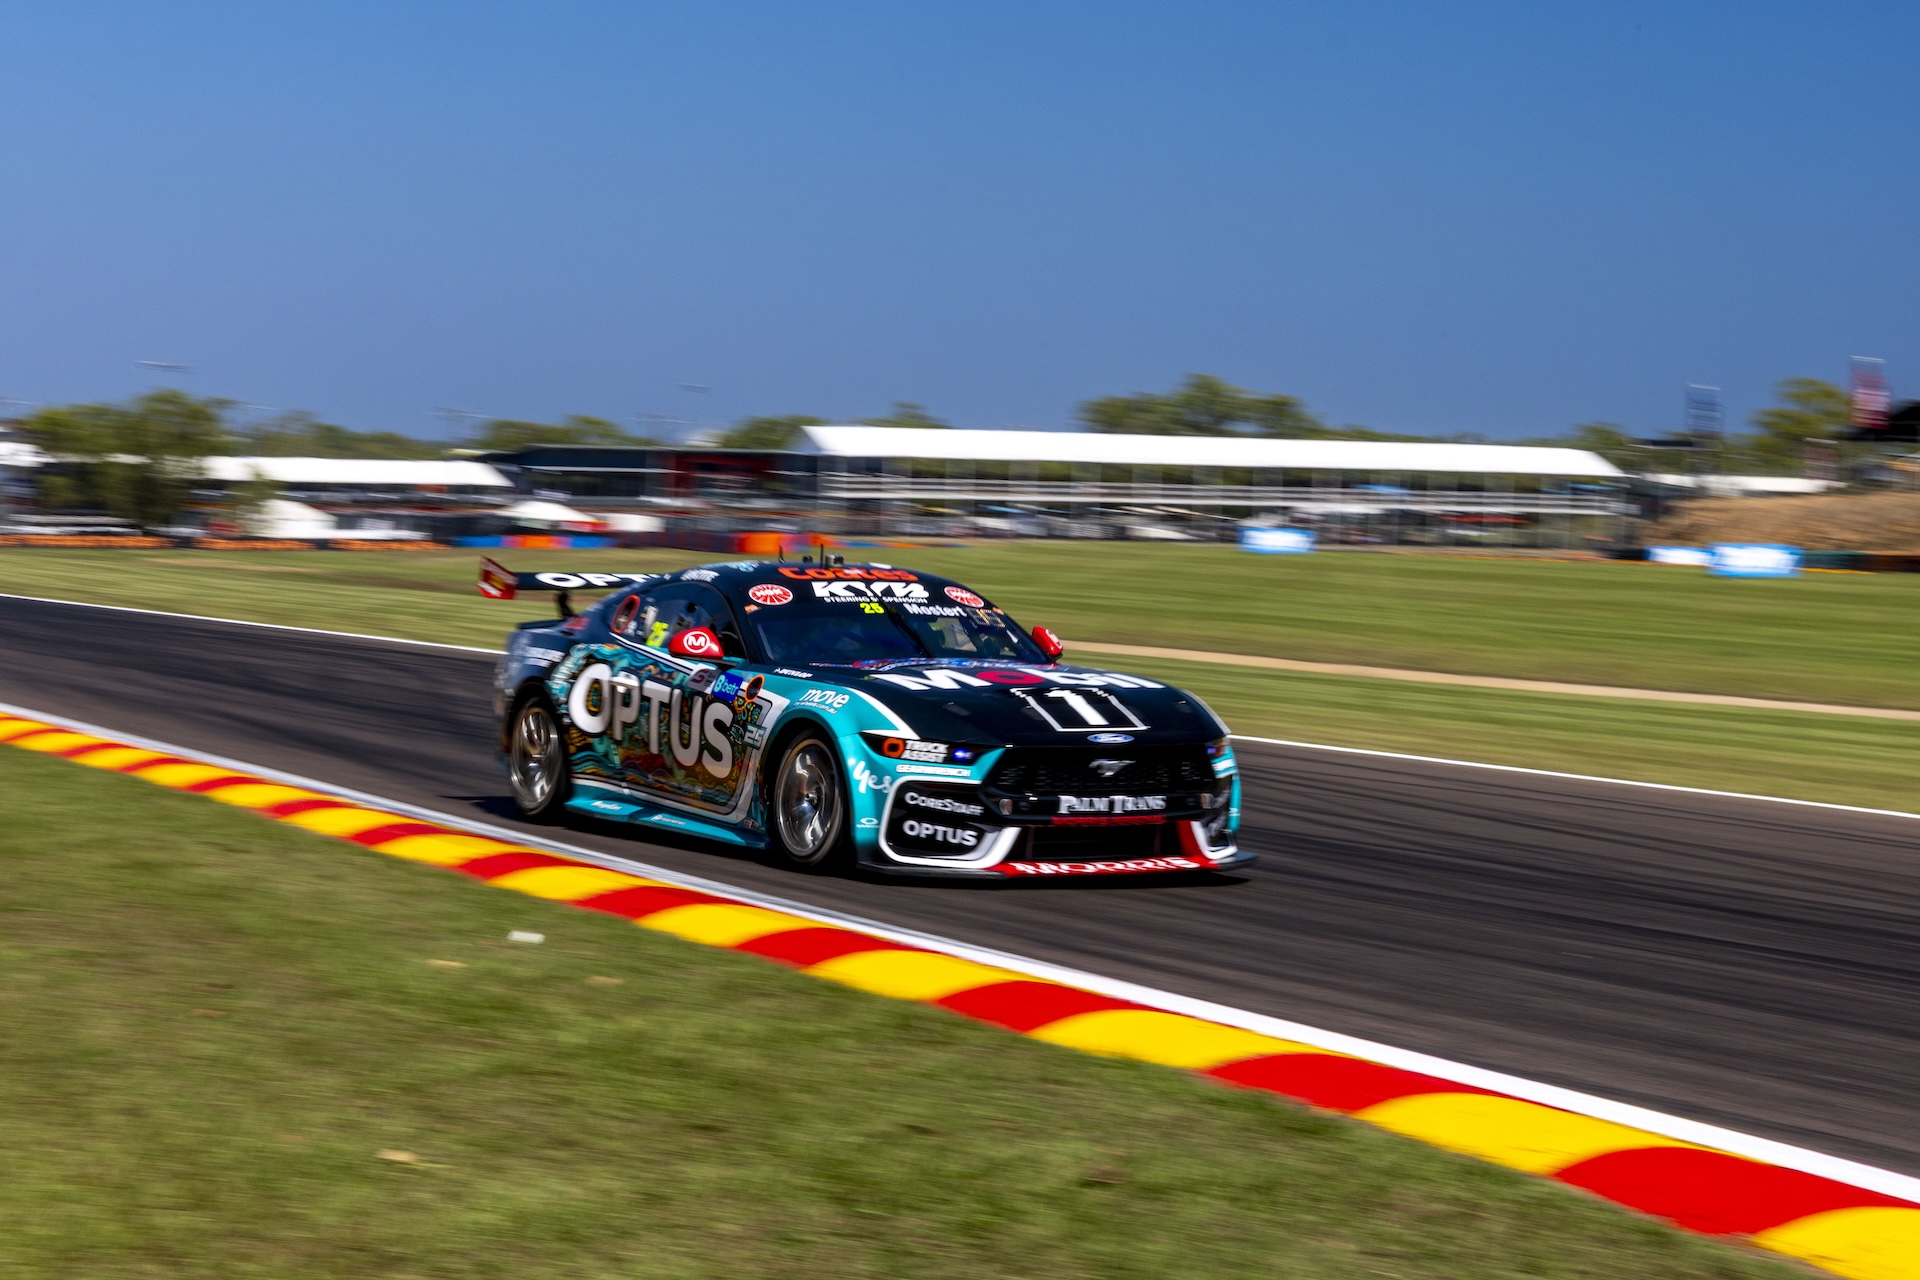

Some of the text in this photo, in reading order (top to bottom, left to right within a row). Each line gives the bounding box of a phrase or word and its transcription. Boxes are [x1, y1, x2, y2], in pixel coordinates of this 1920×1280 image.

[535, 572, 662, 588] OPT
[811, 581, 930, 598] KYB
[859, 602, 884, 614] 25
[903, 603, 967, 617] Mostert
[722, 679, 739, 696] betr
[869, 668, 1166, 690] Mobil
[800, 688, 850, 708] move
[1044, 688, 1110, 726] 1
[568, 662, 733, 779] OPTUS
[743, 725, 765, 748] 25
[905, 740, 949, 753] TRUCK
[901, 751, 947, 763] ASSIST
[853, 760, 892, 794] yes
[1057, 795, 1167, 814] PALM TRANS
[902, 819, 978, 847] OPTUS
[1008, 856, 1200, 874] MORRIS
